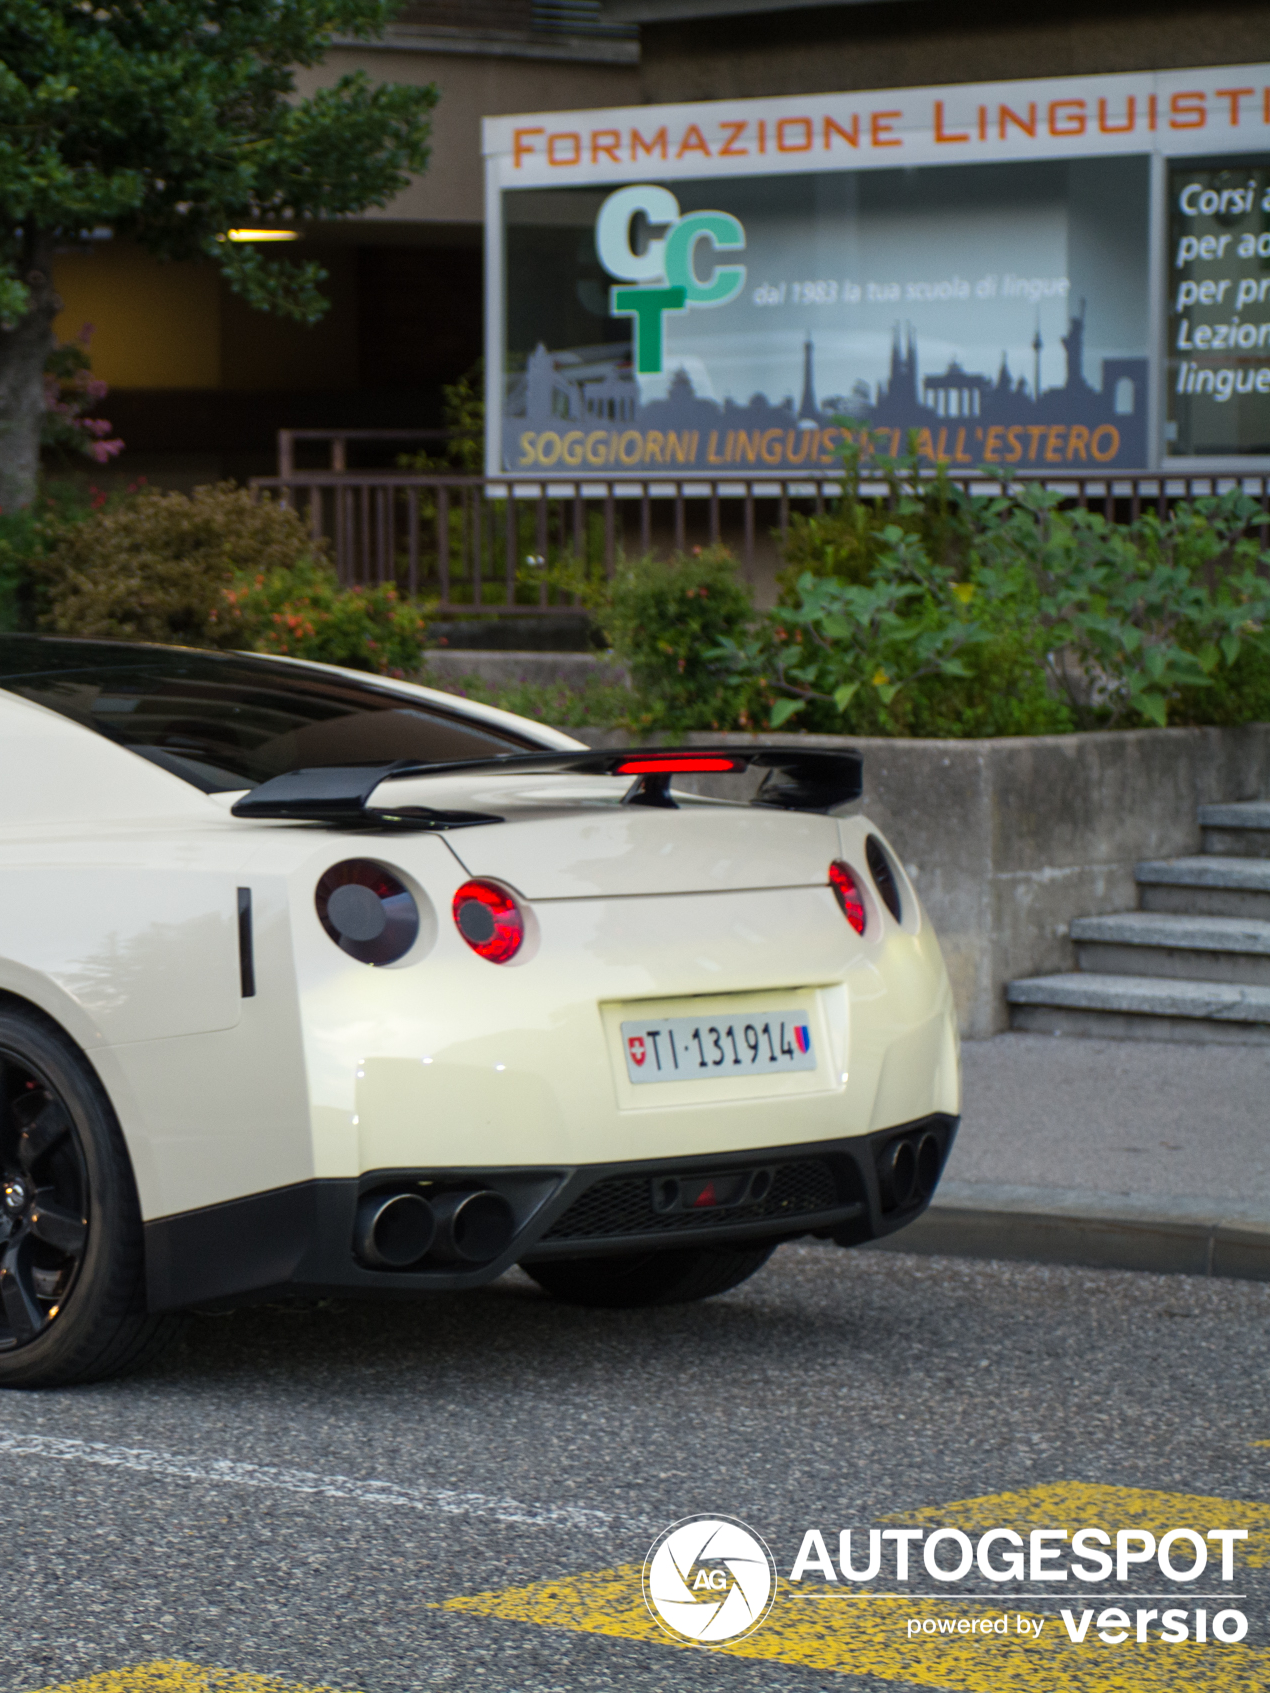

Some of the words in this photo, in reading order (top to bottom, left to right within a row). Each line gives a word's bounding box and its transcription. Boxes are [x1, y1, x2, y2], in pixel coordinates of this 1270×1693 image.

[513, 111, 903, 169] FORMAZIONE
[1179, 179, 1258, 217] Corsi
[1176, 232, 1232, 269] per
[753, 282, 787, 306] dal
[843, 278, 863, 302] la
[867, 280, 902, 302] tua
[905, 275, 971, 301] scuola
[976, 273, 999, 298] di
[1003, 271, 1071, 303] lingue
[1176, 279, 1232, 314] per
[518, 429, 698, 466] SOGGIORNI
[917, 423, 1121, 464] ALL'ESTERO
